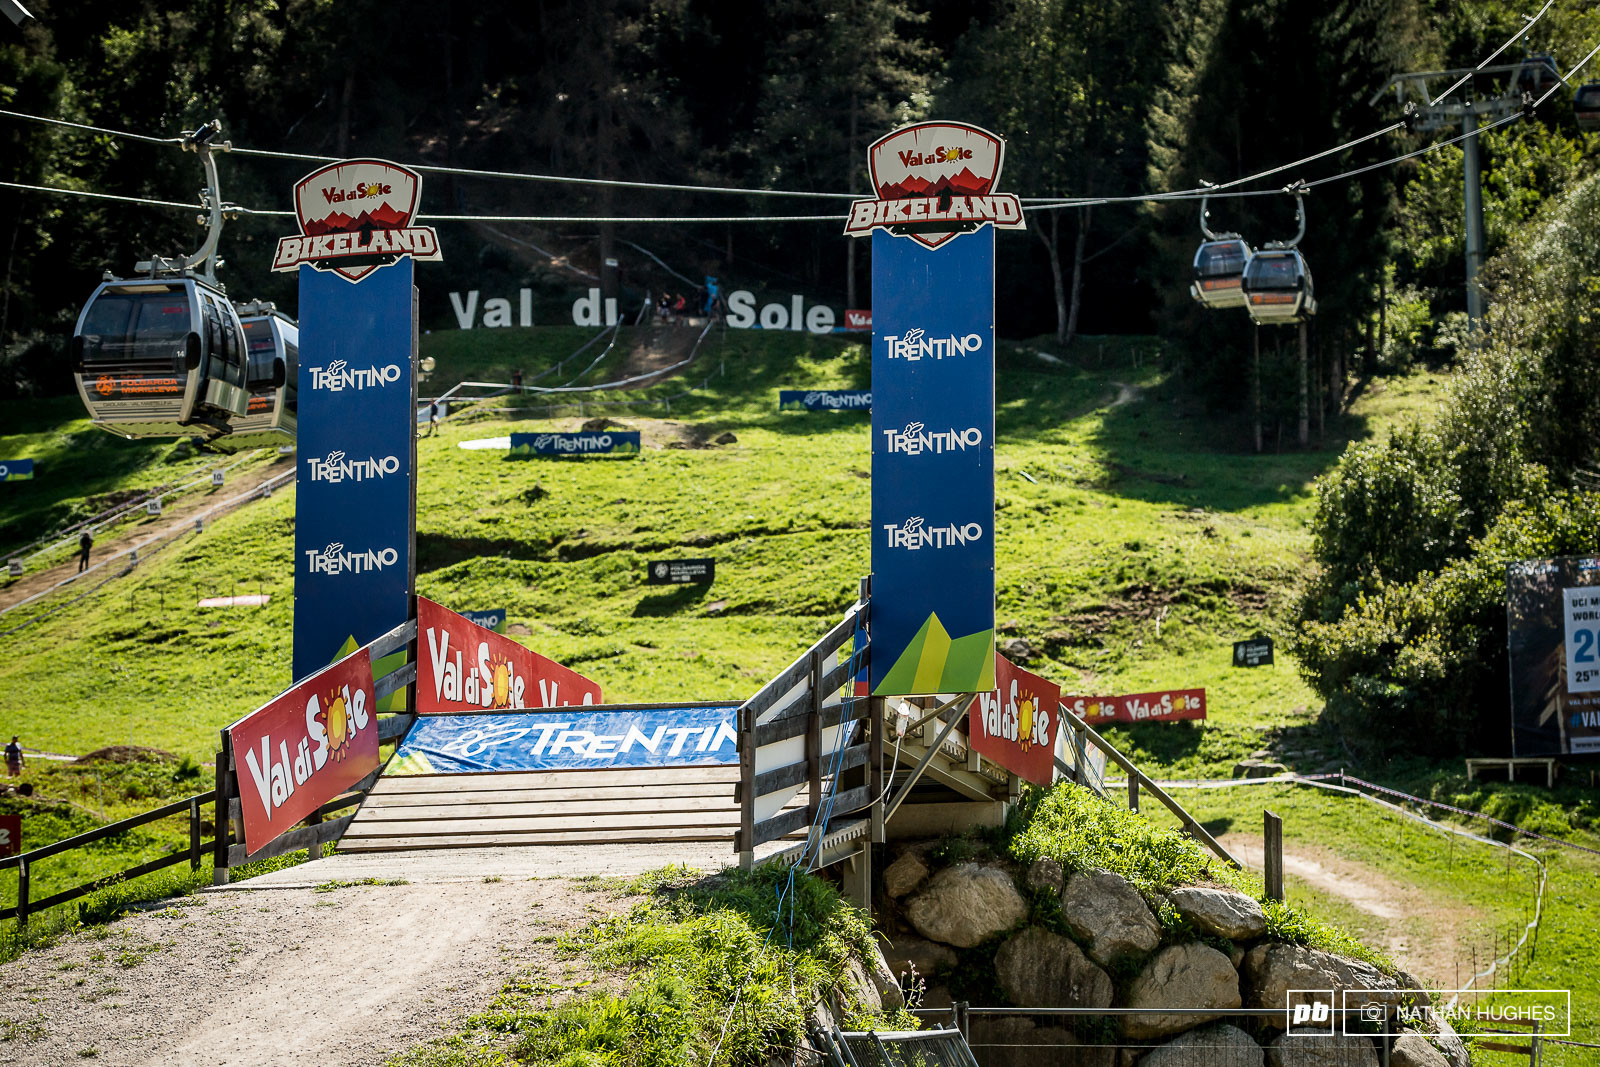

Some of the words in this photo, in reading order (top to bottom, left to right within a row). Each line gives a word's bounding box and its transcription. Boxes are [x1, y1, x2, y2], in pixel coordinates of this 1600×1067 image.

[898, 149, 923, 168] Val
[924, 152, 935, 164] di
[321, 187, 346, 205] Val
[346, 189, 356, 200] di
[849, 196, 1020, 229] BIKELAND
[275, 229, 436, 266] BIKELAND
[449, 288, 533, 330] Val
[572, 287, 618, 327] di
[726, 290, 835, 334] Sole
[883, 333, 983, 361] TRENTINO
[309, 364, 401, 392] TRENTINO
[821, 392, 873, 408] TRENTINO
[552, 435, 612, 452] TRENTINO
[883, 427, 982, 455] TRENTINO
[307, 455, 400, 483] TRENTINO
[883, 522, 983, 550] TRENTINO
[305, 547, 398, 575] TRENTINO
[1572, 598, 1587, 608] UCI
[1573, 611, 1600, 621] WORL
[426, 627, 463, 703] Val
[464, 667, 480, 705] di
[478, 642, 526, 709] Sole
[979, 689, 1001, 739] Val
[1002, 703, 1010, 740] di
[1010, 679, 1050, 747] Sole
[1126, 699, 1150, 720] Val
[1150, 704, 1162, 717] di
[245, 735, 295, 822] Val
[294, 736, 313, 786] di
[306, 684, 369, 771] Sole
[529, 719, 738, 759] TRENTIN
